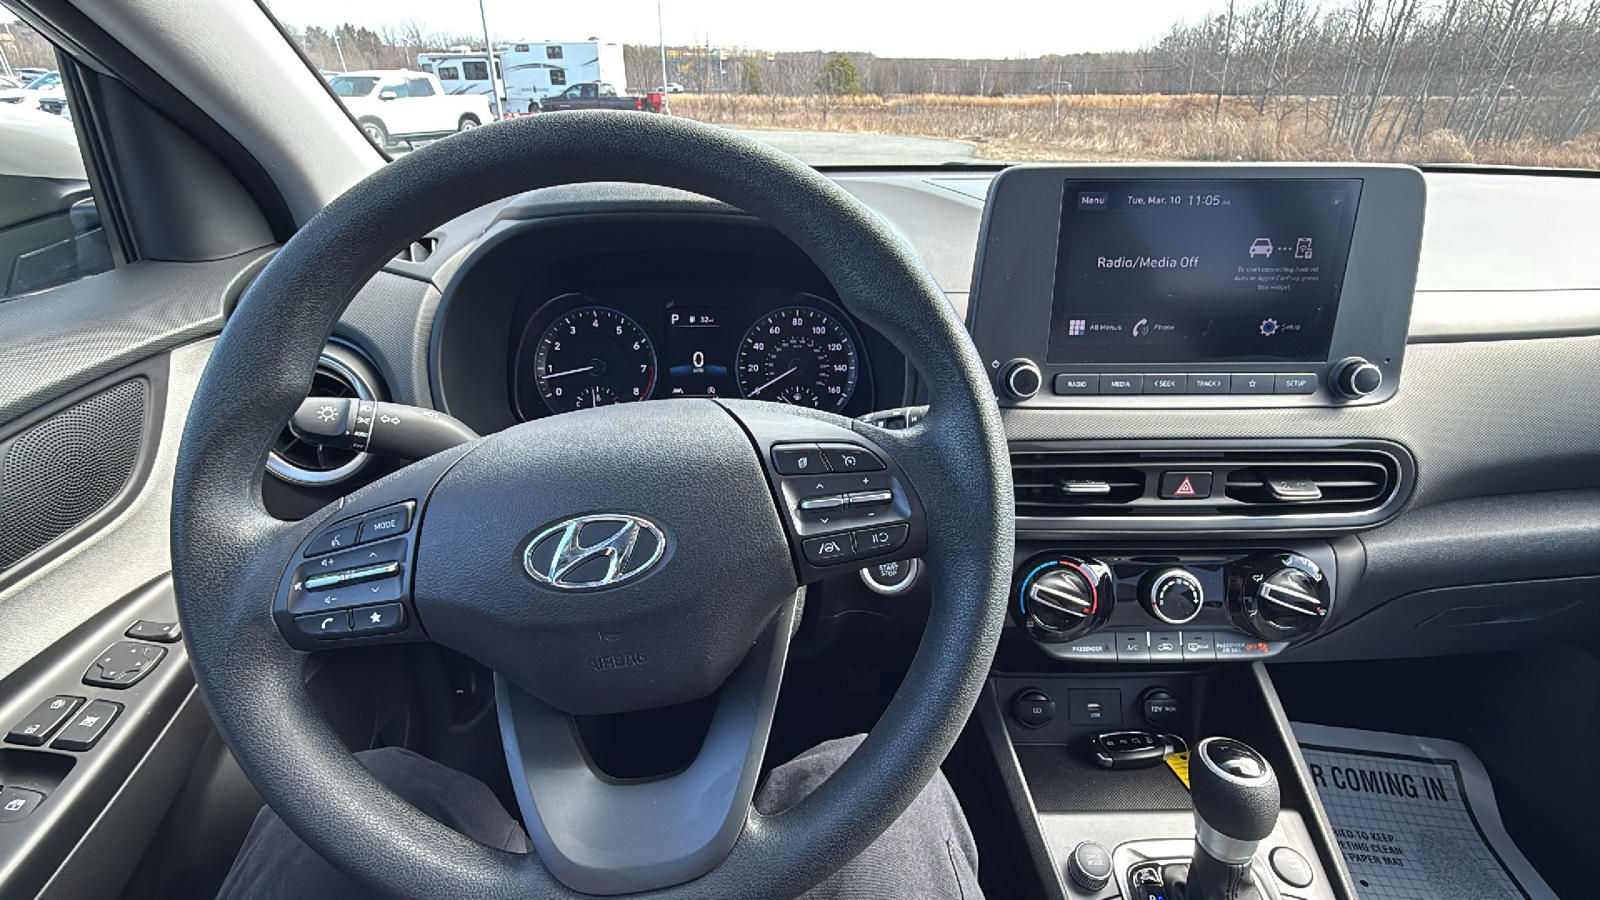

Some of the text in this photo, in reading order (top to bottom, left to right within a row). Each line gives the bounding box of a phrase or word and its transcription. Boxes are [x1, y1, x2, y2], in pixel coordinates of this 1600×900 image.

[1081, 196, 1105, 204] Menu
[1128, 196, 1146, 206] Tue,
[1148, 196, 1167, 204] Mar.
[1170, 196, 1181, 204] 10
[1188, 194, 1220, 206] 11:05
[1097, 256, 1200, 269] Radio/Media Off
[672, 314, 680, 324] P
[792, 318, 803, 326] 80
[592, 319, 598, 328] 4
[570, 326, 576, 334] 3
[616, 326, 622, 334] 5
[770, 326, 780, 334] 60
[812, 326, 826, 334] 100
[554, 342, 560, 350] 2
[634, 342, 640, 350] 6
[753, 342, 764, 350] 40
[828, 343, 842, 351] 120
[692, 352, 704, 368] 0
[548, 364, 552, 372] 1
[640, 364, 647, 373] 7
[748, 364, 758, 372] 20
[834, 364, 847, 372] 140
[556, 388, 562, 396] 0
[633, 387, 640, 395] 8
[374, 520, 396, 530] MODE
[588, 653, 647, 672] AIRBAG
[1331, 766, 1418, 798] COMING
[1422, 776, 1448, 802] IN
[1355, 829, 1369, 840] TO
[1370, 832, 1394, 842] KEEP
[1371, 844, 1403, 856] CLEAN
[1348, 853, 1382, 864] PAPER
[1382, 856, 1404, 868] MAT
